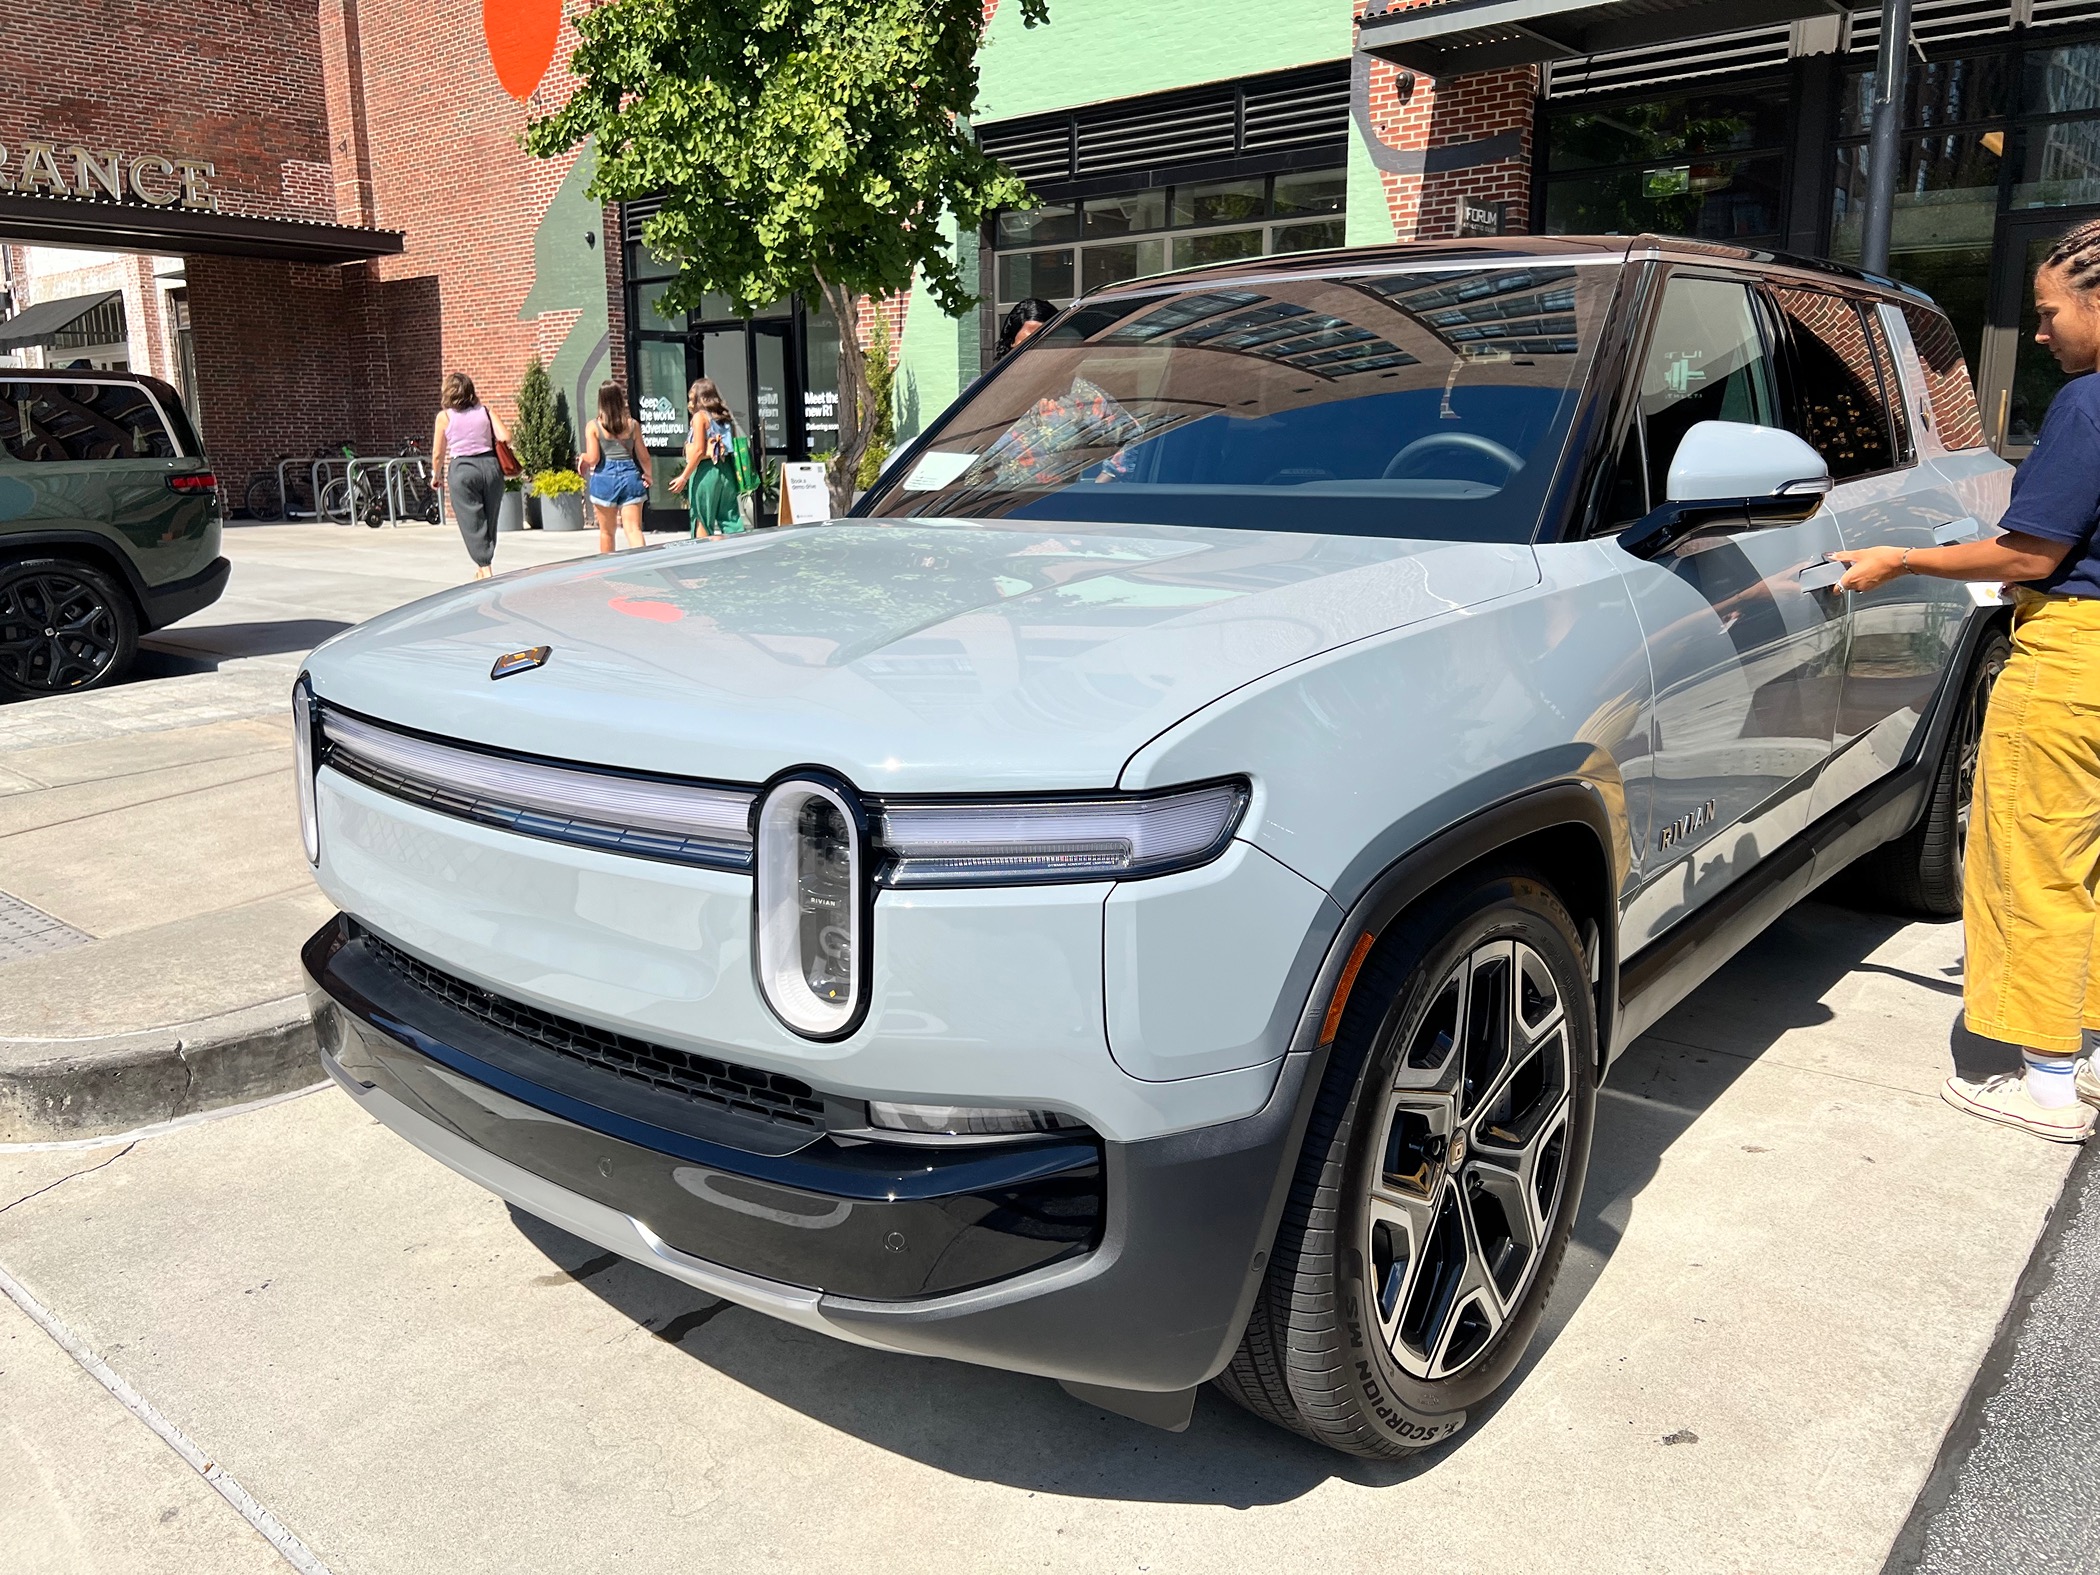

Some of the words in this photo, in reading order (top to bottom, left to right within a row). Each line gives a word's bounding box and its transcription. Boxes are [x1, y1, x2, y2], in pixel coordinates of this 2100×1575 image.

[1466, 207, 1497, 226] FORUM
[804, 391, 825, 405] Meet
[826, 391, 838, 404] the
[640, 409, 652, 421] the
[653, 408, 676, 421] world
[805, 407, 822, 417] new
[822, 404, 833, 417] R1
[641, 422, 686, 434] adventurou
[1658, 798, 1716, 852] RIVIAN
[811, 897, 836, 907] RIVIAN
[1346, 1296, 1363, 1348] MS
[1355, 1359, 1439, 1441] SCORPION
